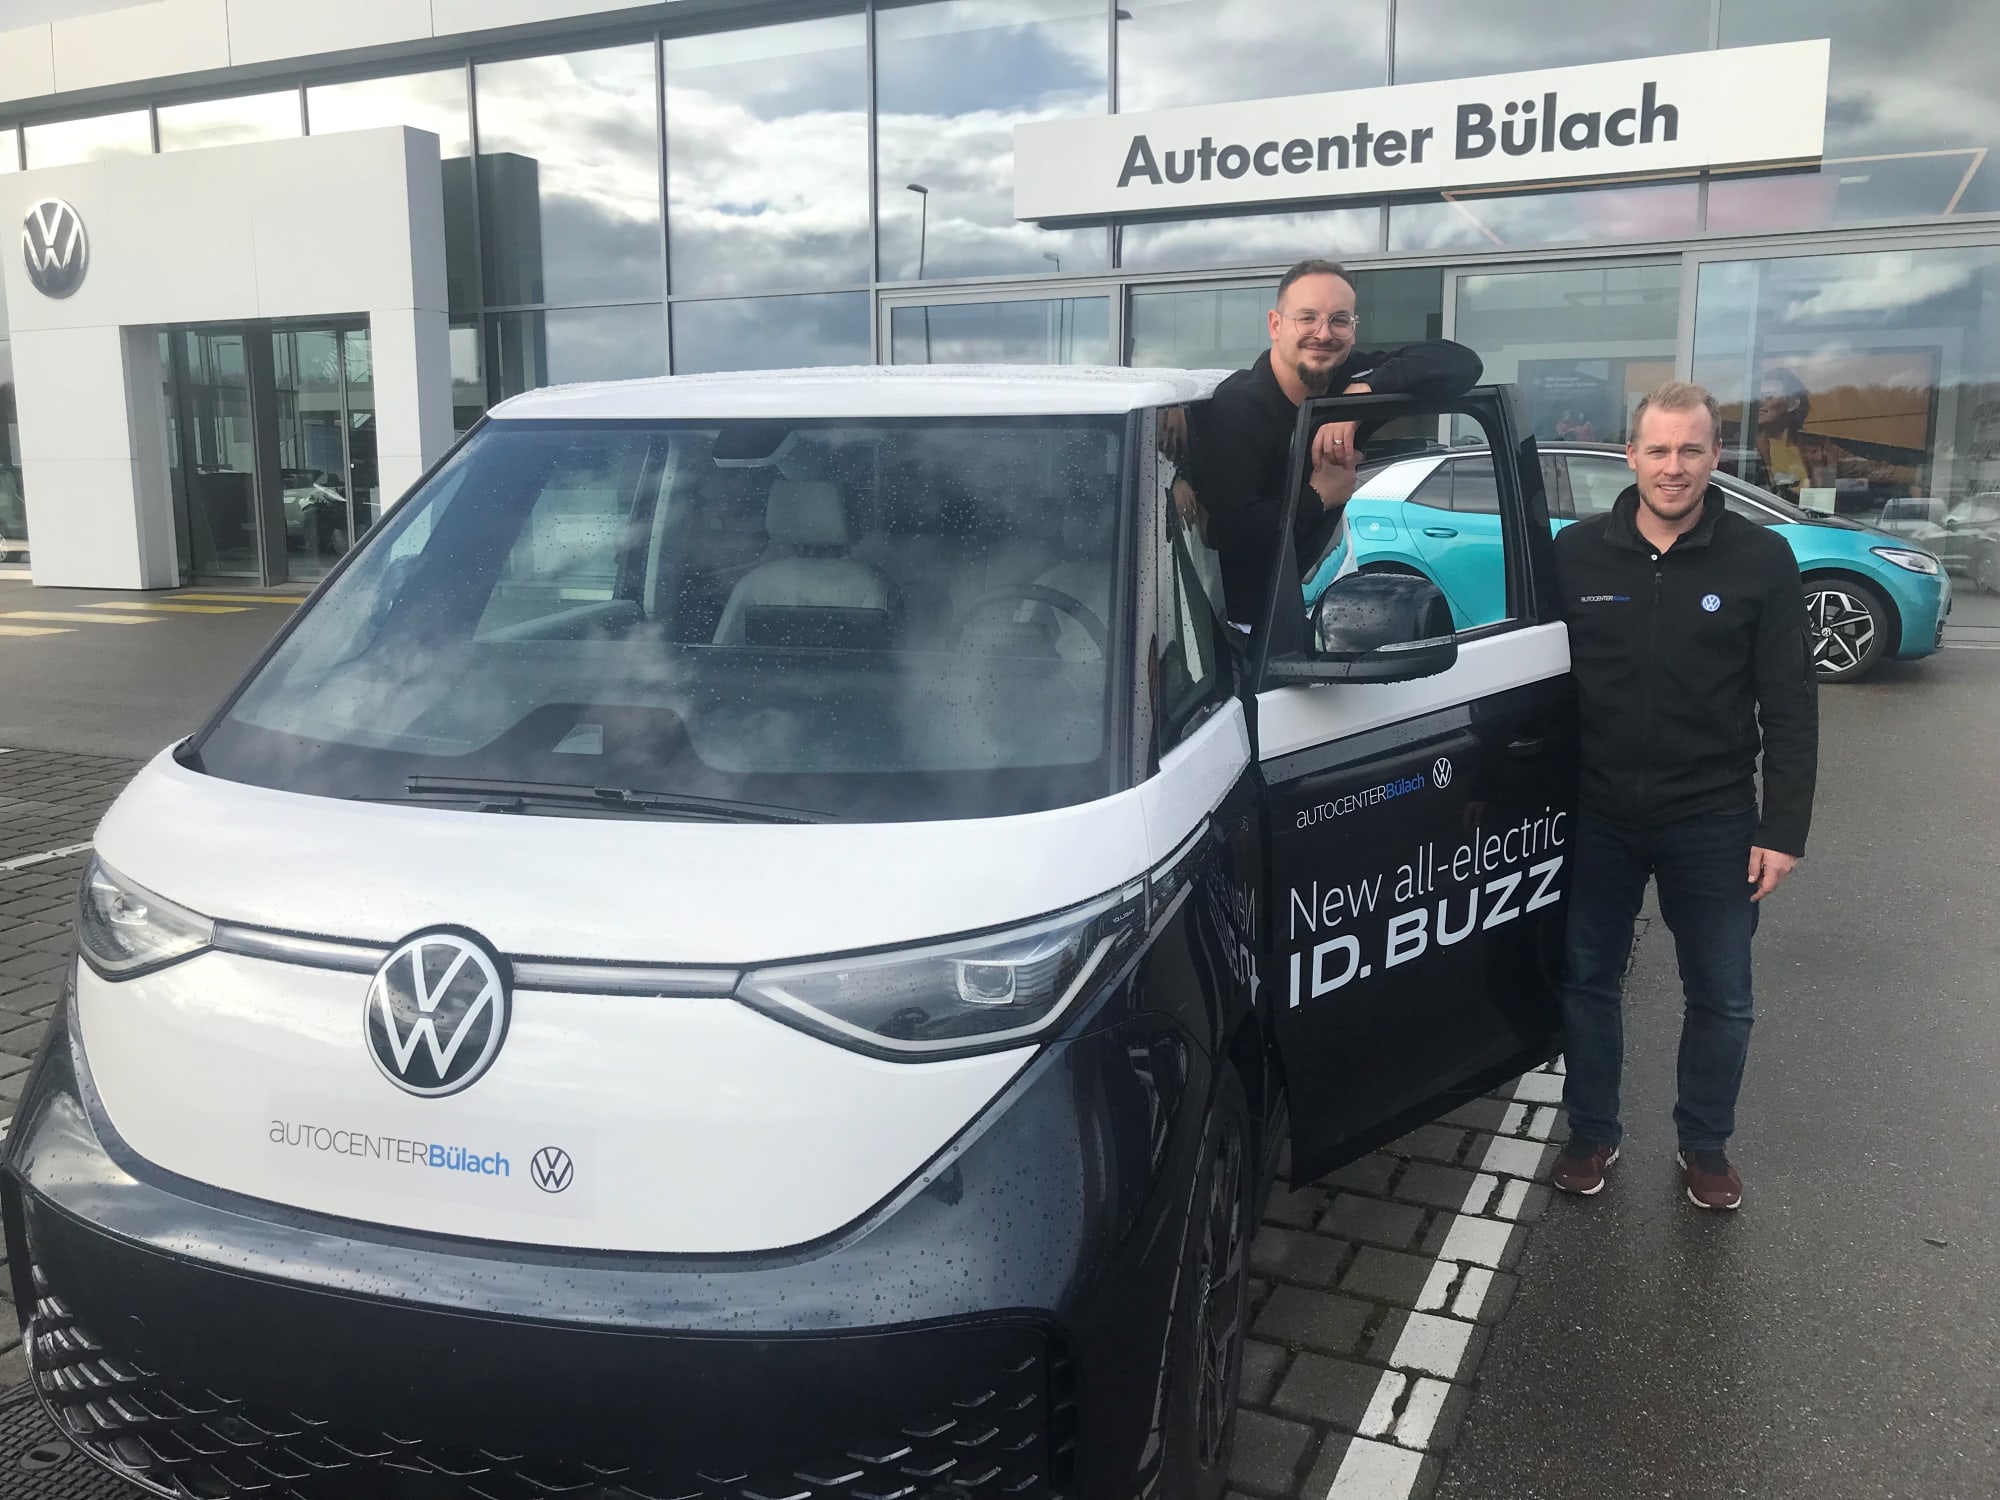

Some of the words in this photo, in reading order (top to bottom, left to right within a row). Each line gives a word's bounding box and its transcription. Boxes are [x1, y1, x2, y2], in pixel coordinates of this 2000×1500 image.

[1117, 121, 1433, 189] Autocenter
[1454, 81, 1679, 160] Bülach
[1289, 934, 1372, 1008] ID.
[1385, 856, 1564, 968] BUZZ
[1290, 873, 1383, 940] New
[1395, 806, 1567, 902] all-electric
